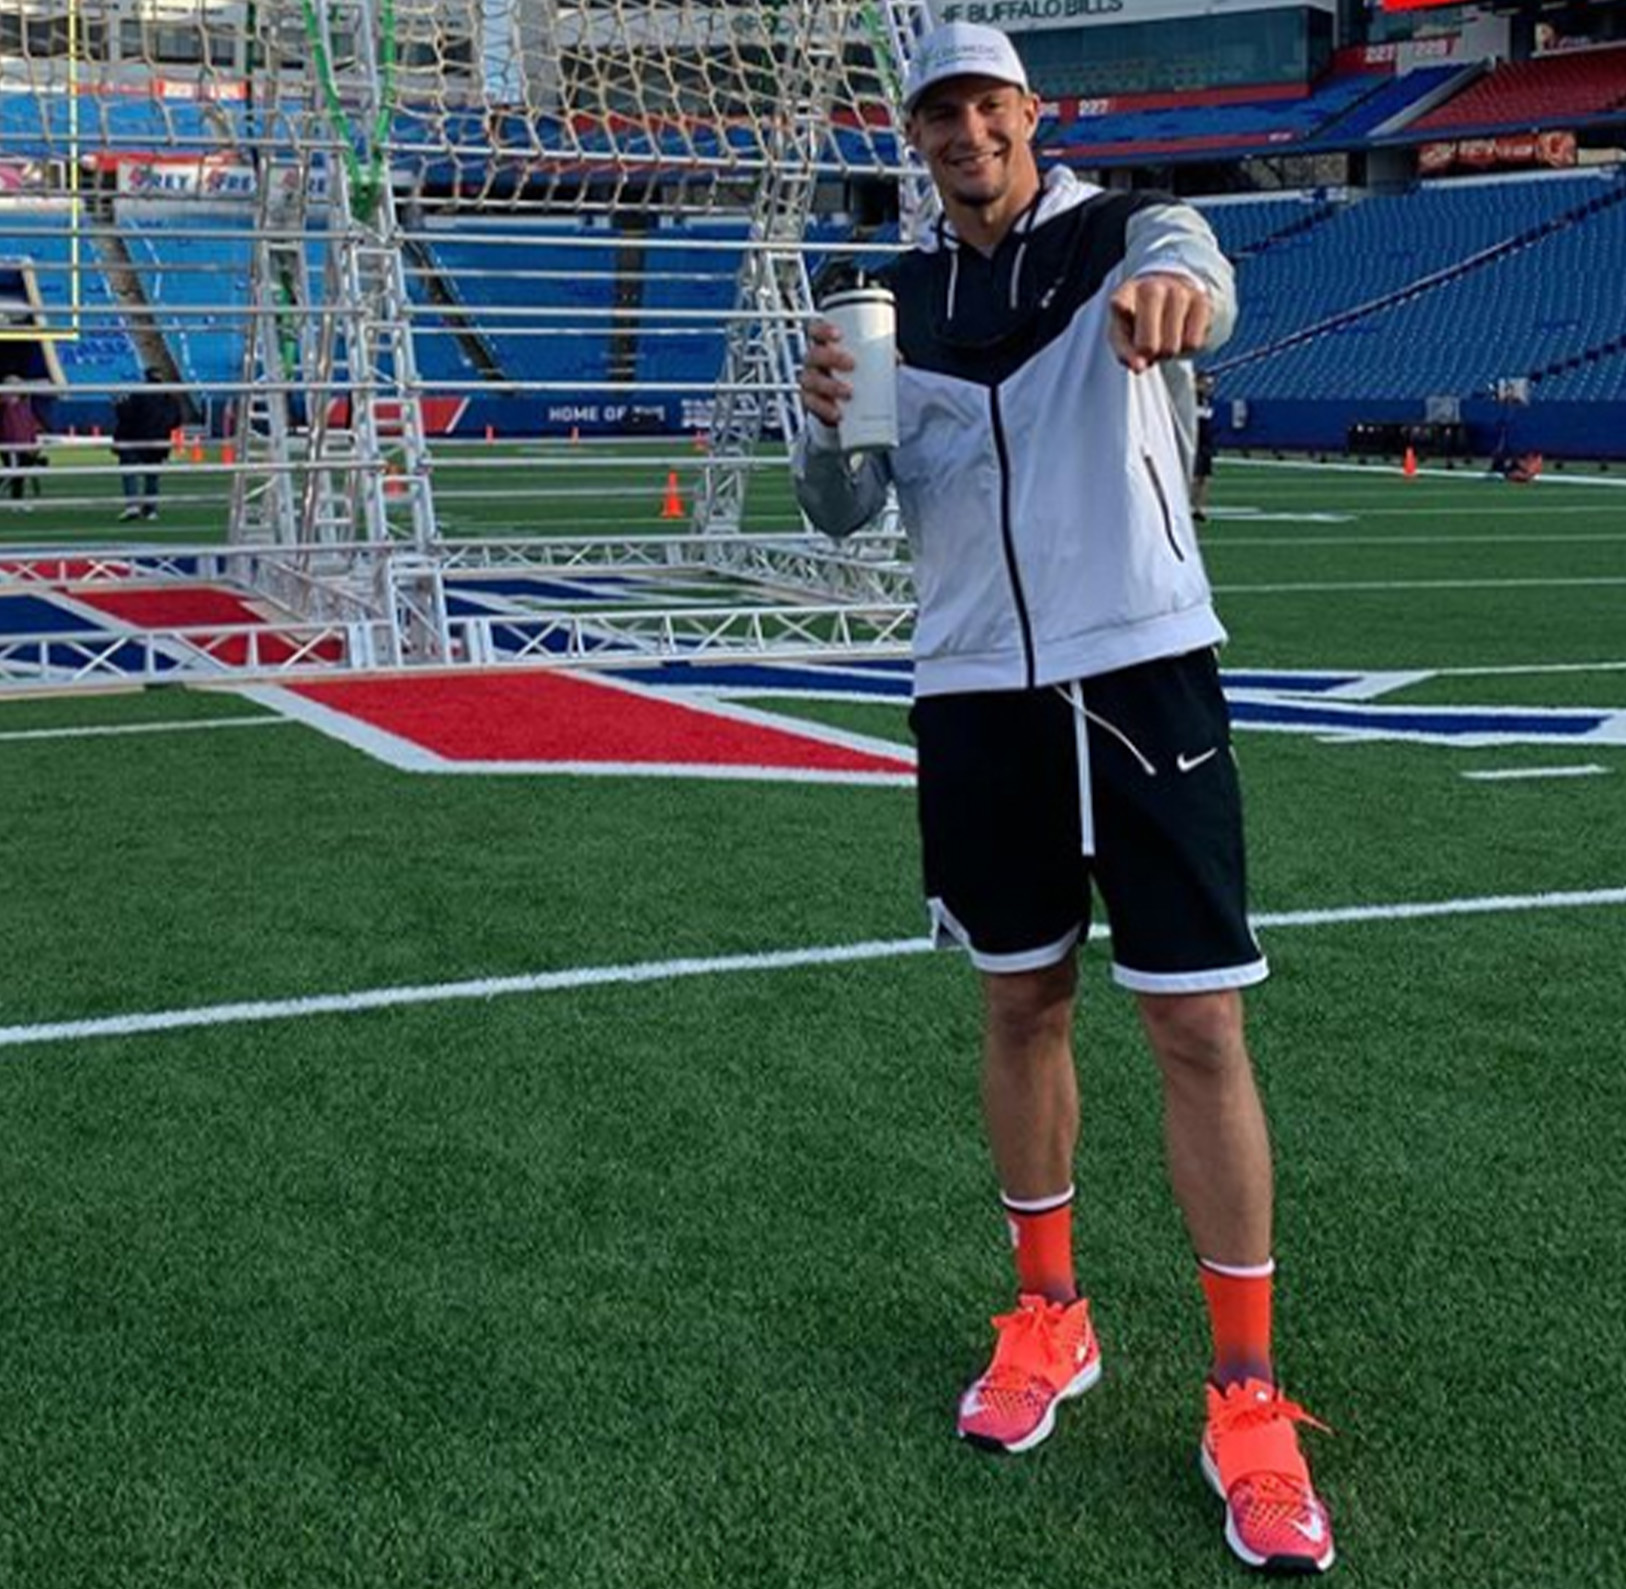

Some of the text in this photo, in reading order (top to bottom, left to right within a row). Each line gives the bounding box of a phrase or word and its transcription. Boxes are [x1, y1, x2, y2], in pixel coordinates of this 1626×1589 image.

[967, 0, 1062, 24] BUFFALO
[1064, 0, 1123, 16] BILLS
[211, 172, 256, 191] FRE
[549, 405, 599, 421] HOME
[603, 405, 628, 421] OF
